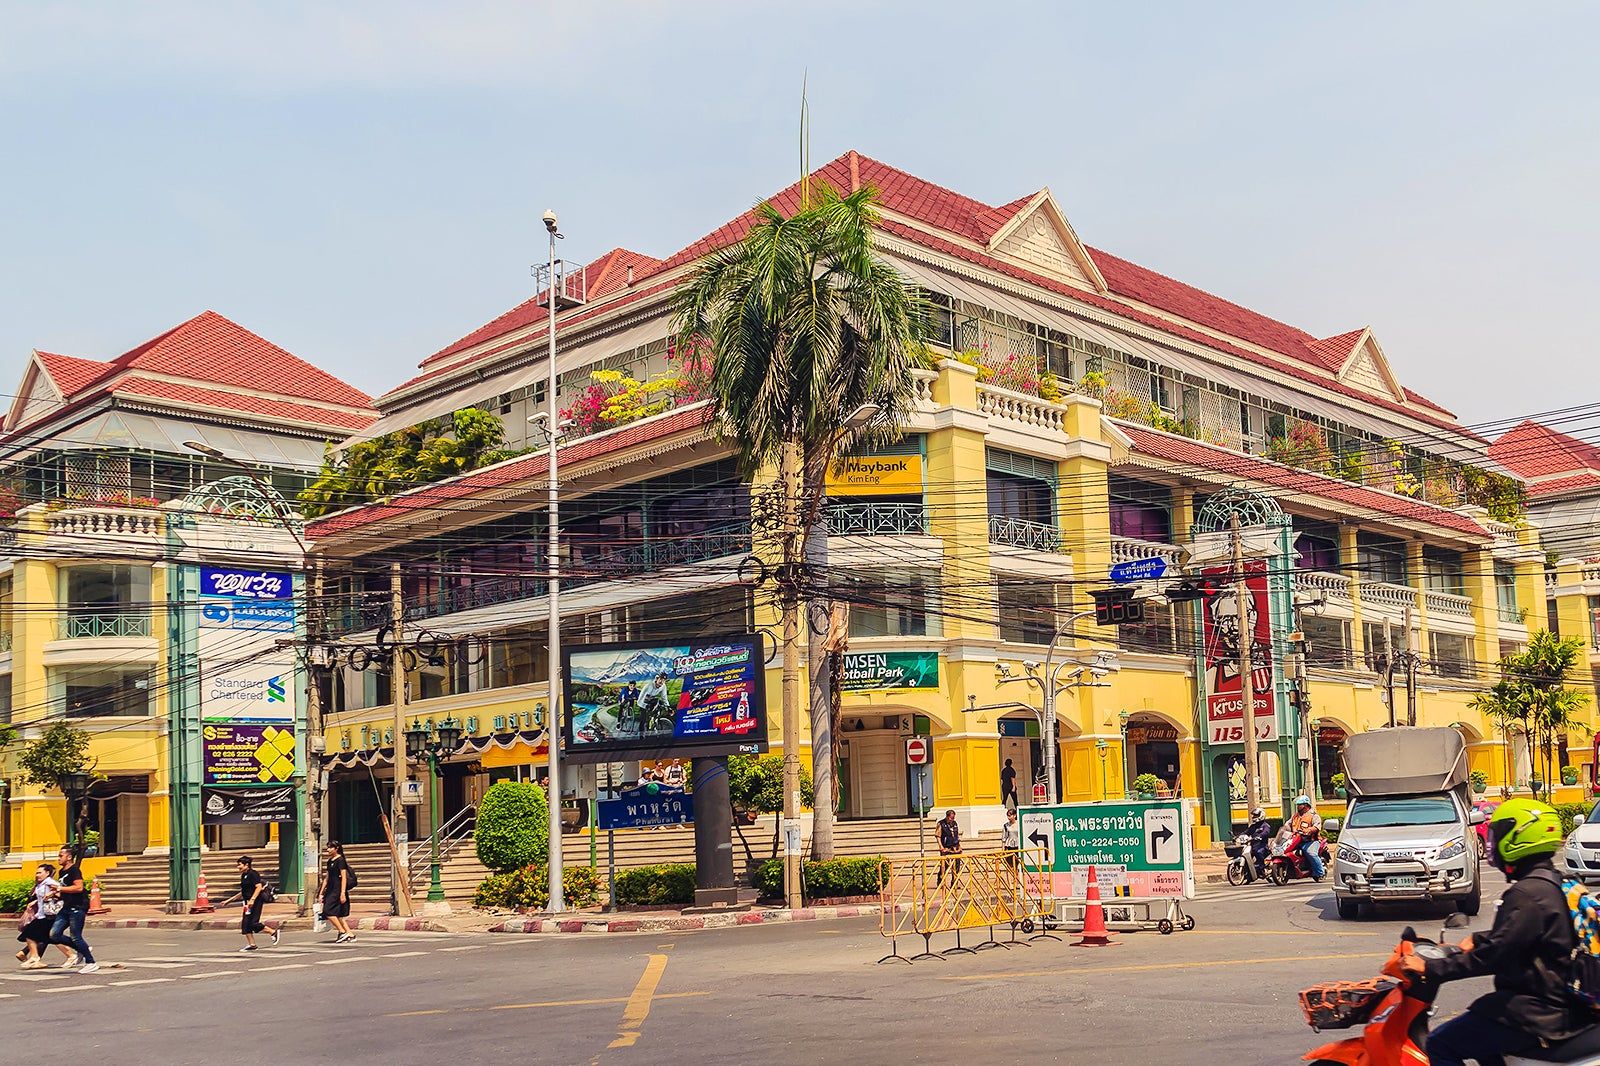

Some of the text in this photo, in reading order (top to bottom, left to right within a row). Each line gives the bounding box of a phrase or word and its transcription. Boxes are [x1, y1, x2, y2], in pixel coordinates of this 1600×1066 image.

[848, 461, 908, 474] Maybank
[848, 475, 880, 484] Kim Eng
[877, 666, 904, 678] Park
[215, 677, 263, 688] Standard
[211, 689, 263, 700] Chartered
[627, 798, 682, 818] พาหุรัด
[1055, 810, 1143, 832] สน.พระราชวัง
[1062, 835, 1140, 848] โทร. 0-2224-5050
[1119, 853, 1134, 863] 191
